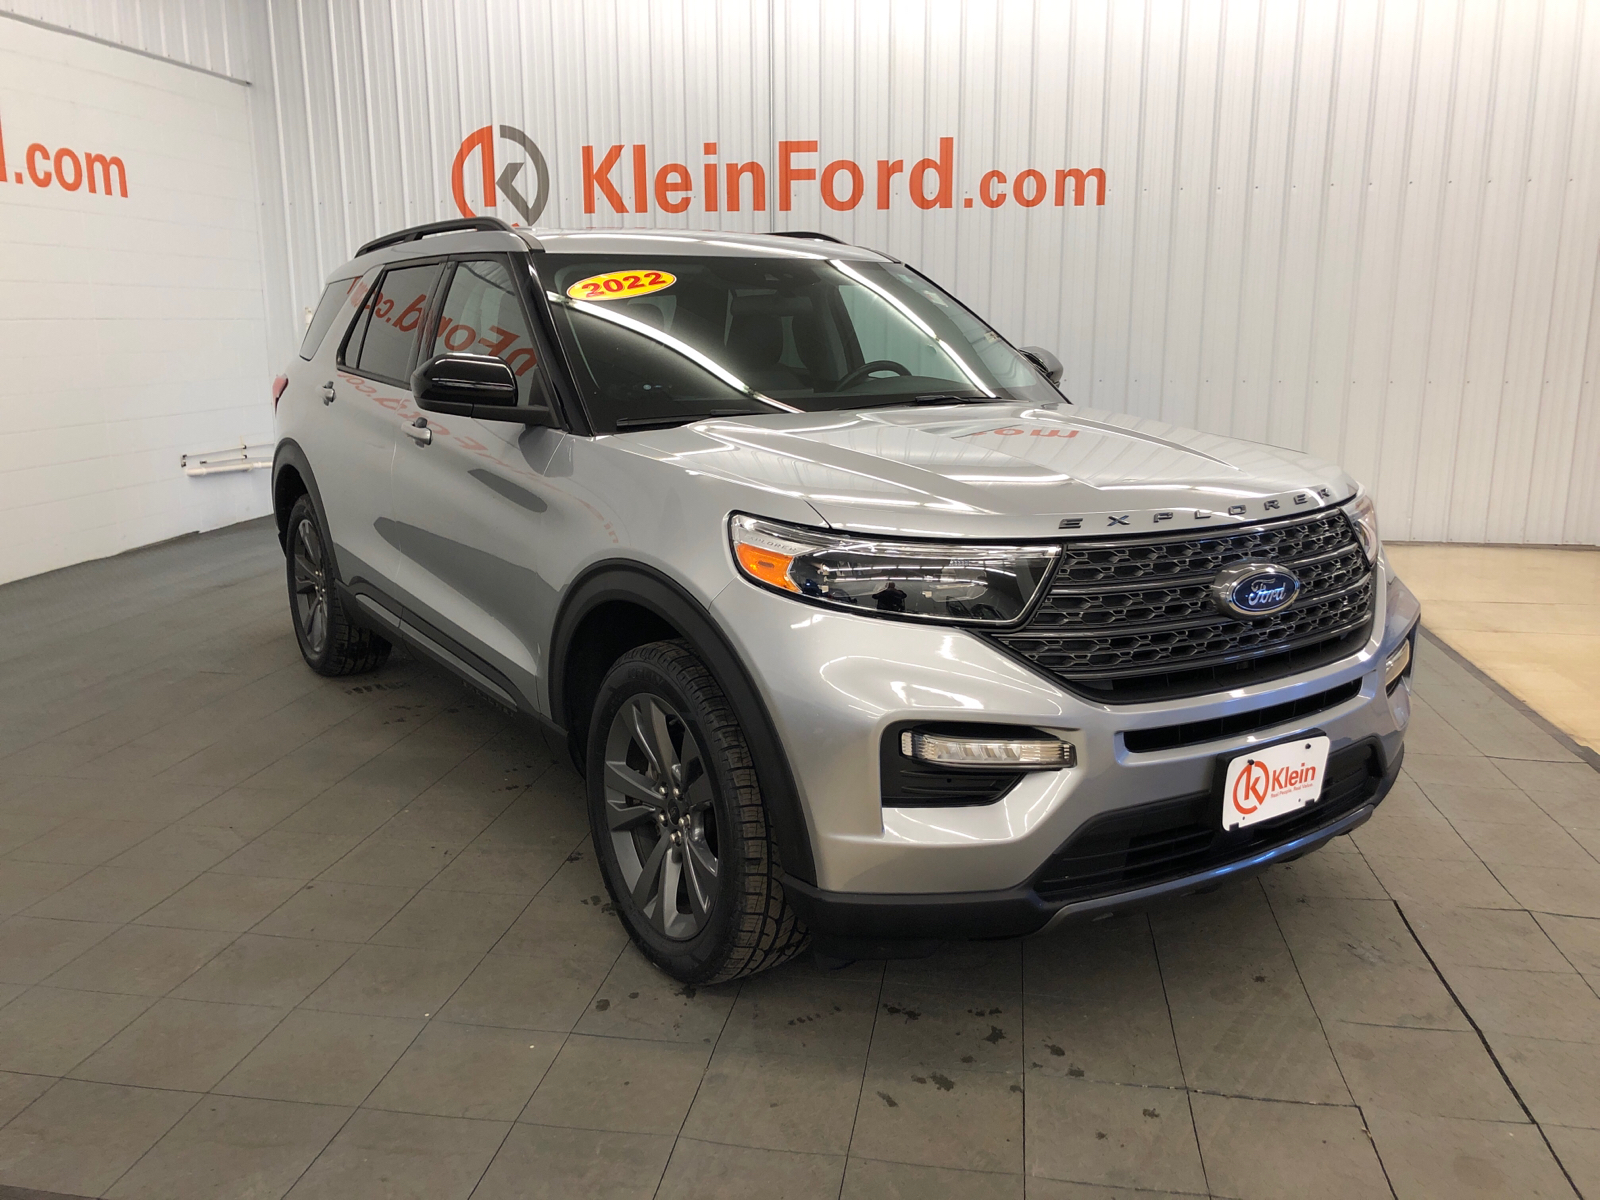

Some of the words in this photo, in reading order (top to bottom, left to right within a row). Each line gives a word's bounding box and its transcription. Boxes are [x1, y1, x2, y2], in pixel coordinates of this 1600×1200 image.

[581, 136, 1107, 214] KleinFord.com
[581, 271, 668, 298] 2022
[1058, 487, 1331, 530] EXPLORER
[1248, 578, 1286, 606] Ford
[1271, 762, 1317, 792] Klein
